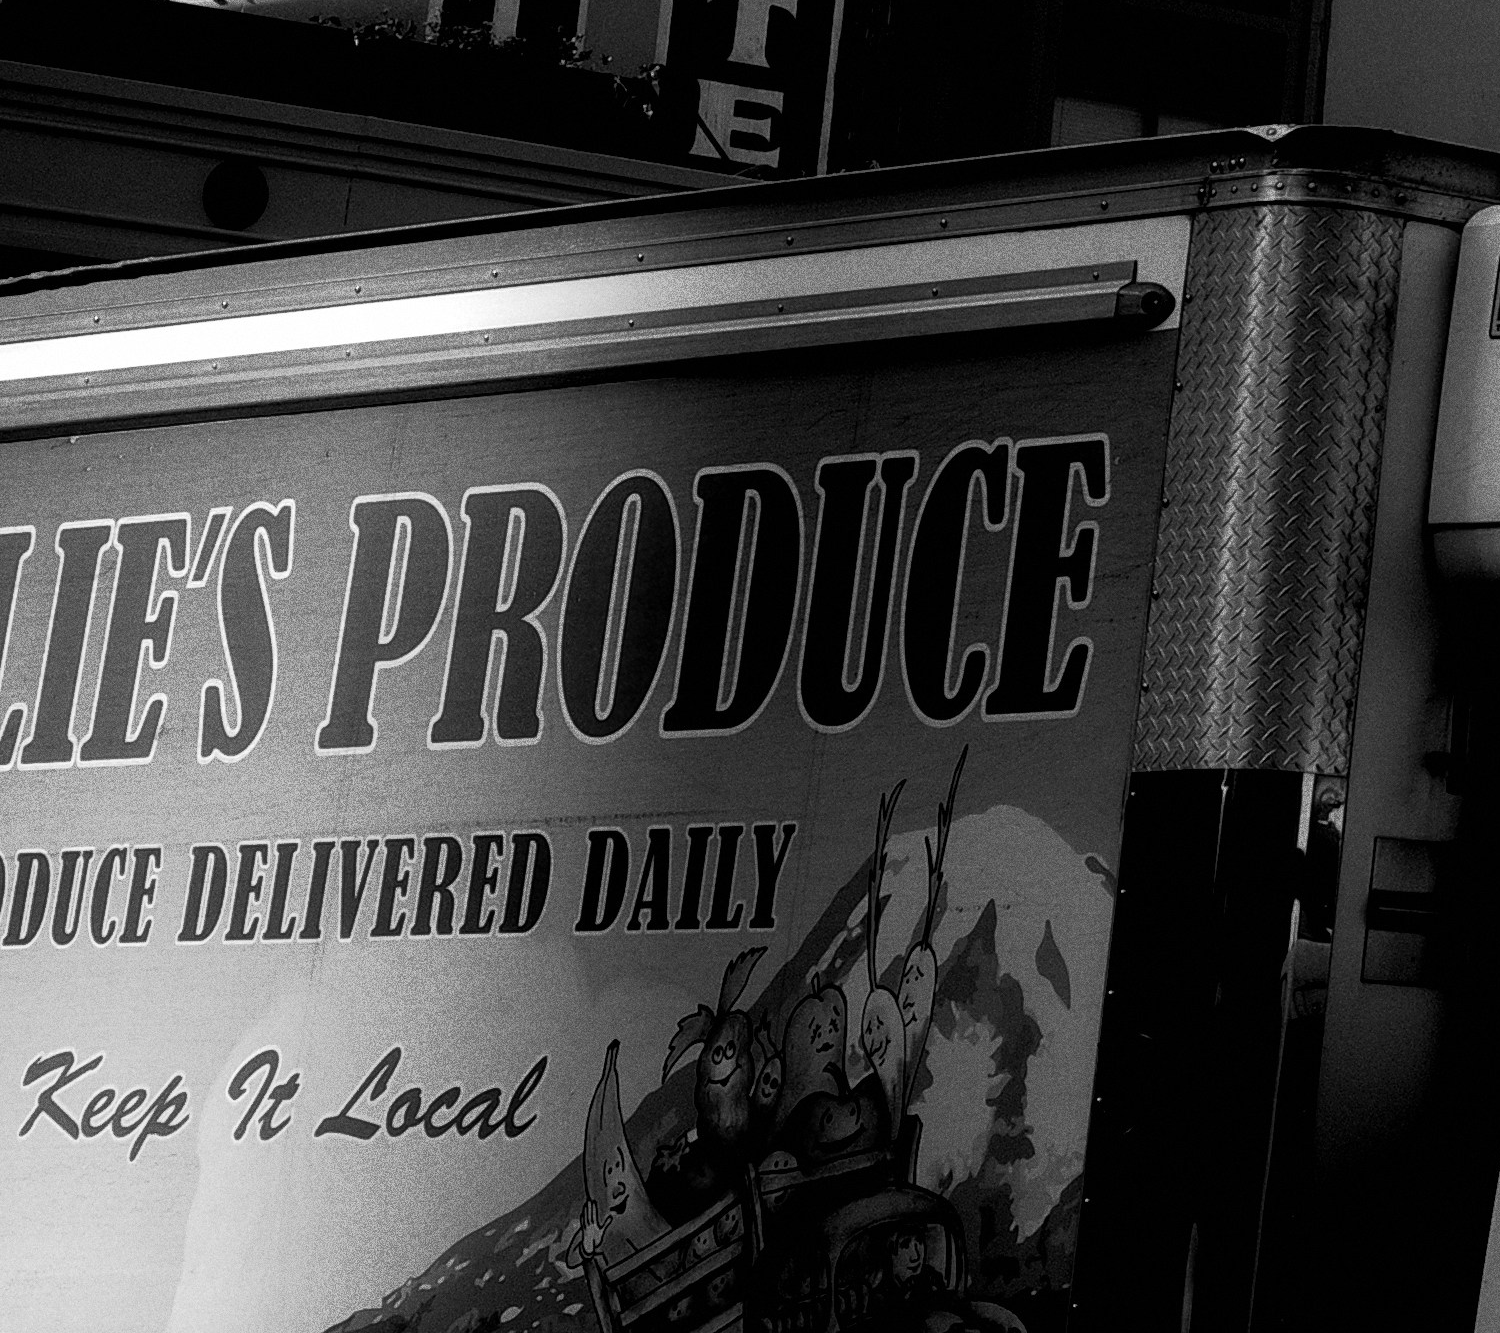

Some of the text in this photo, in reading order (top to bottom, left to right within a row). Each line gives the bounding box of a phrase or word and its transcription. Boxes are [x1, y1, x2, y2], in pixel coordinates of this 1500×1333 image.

[315, 432, 1110, 759] PRODUCE
[0, 821, 798, 947] DUCE DELIVERED DAILY
[19, 1047, 551, 1163] Keep It Local
